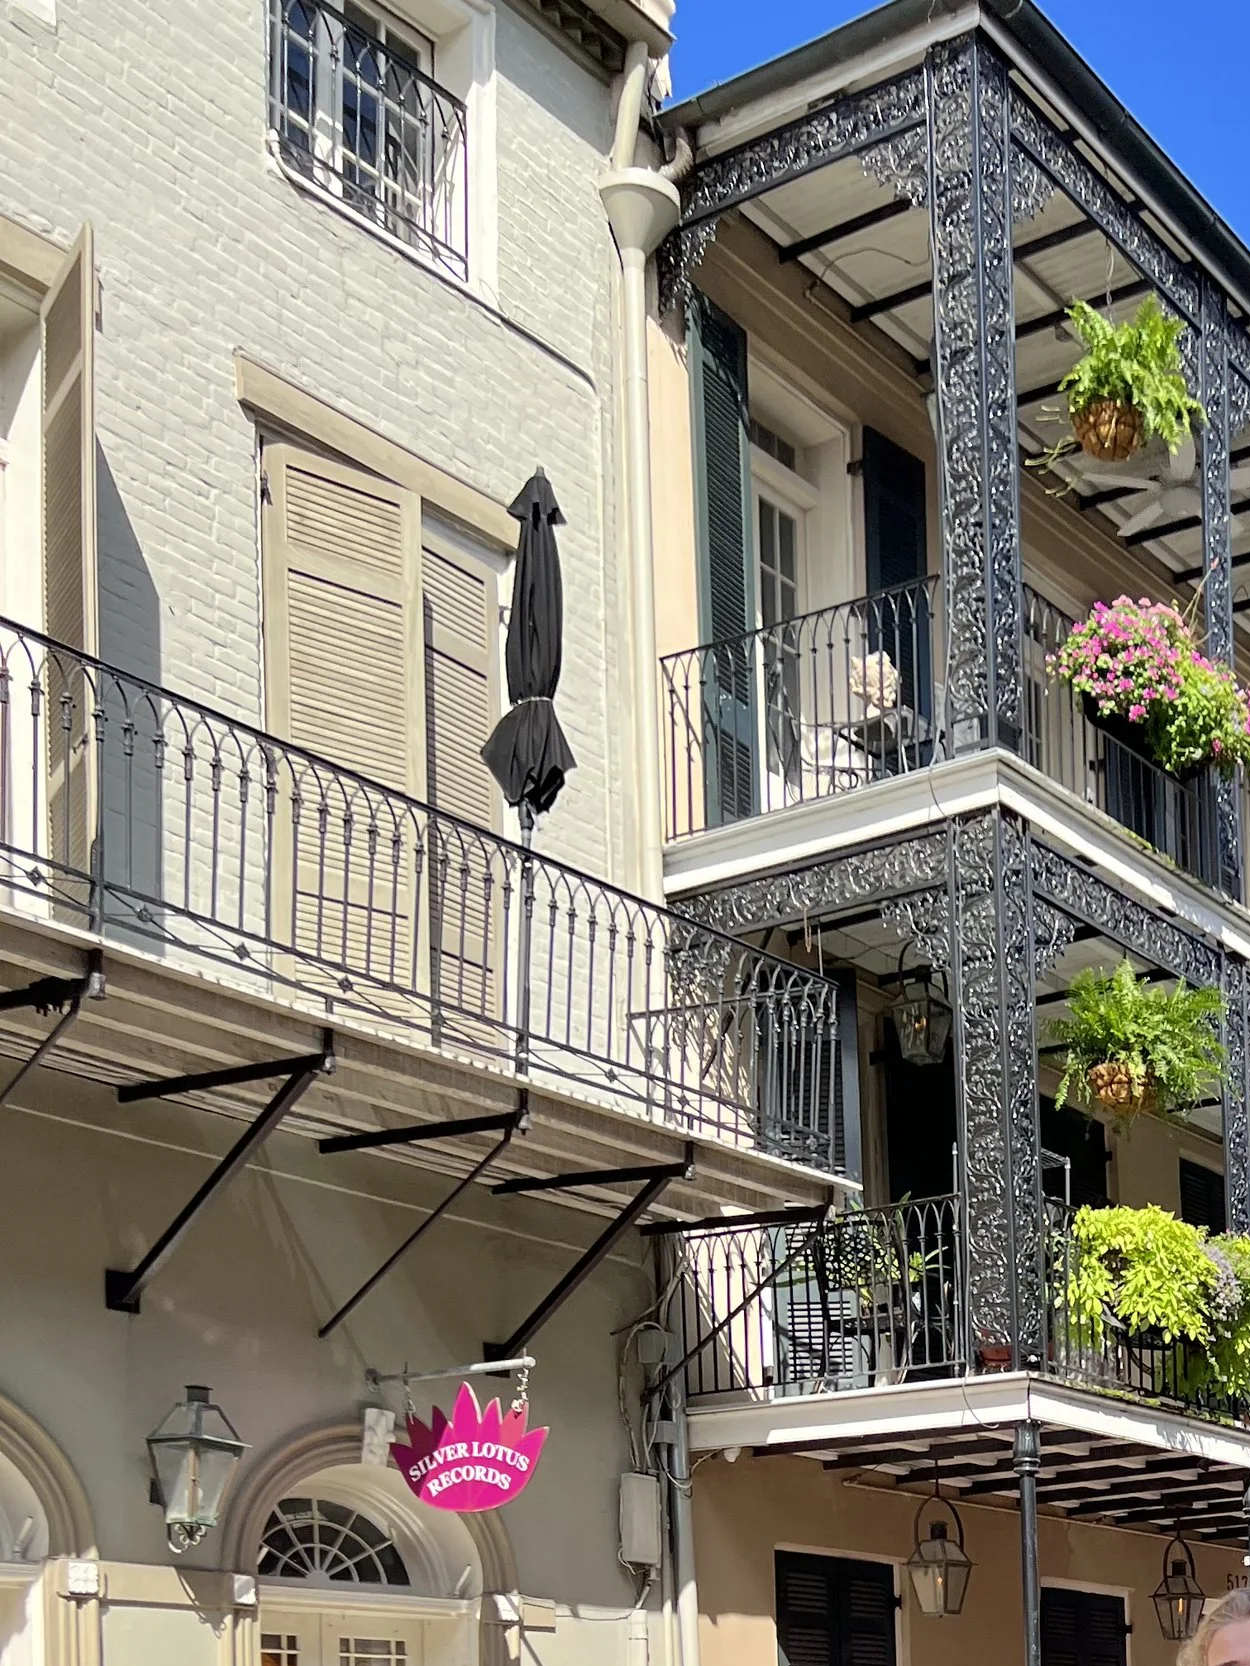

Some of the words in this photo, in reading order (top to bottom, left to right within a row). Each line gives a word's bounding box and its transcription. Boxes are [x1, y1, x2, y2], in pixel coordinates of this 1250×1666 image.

[409, 1442, 470, 1482] SILVER
[472, 1441, 530, 1472] LOTUS
[427, 1465, 511, 1497] RECORDS
[1226, 1573, 1248, 1591] 517
